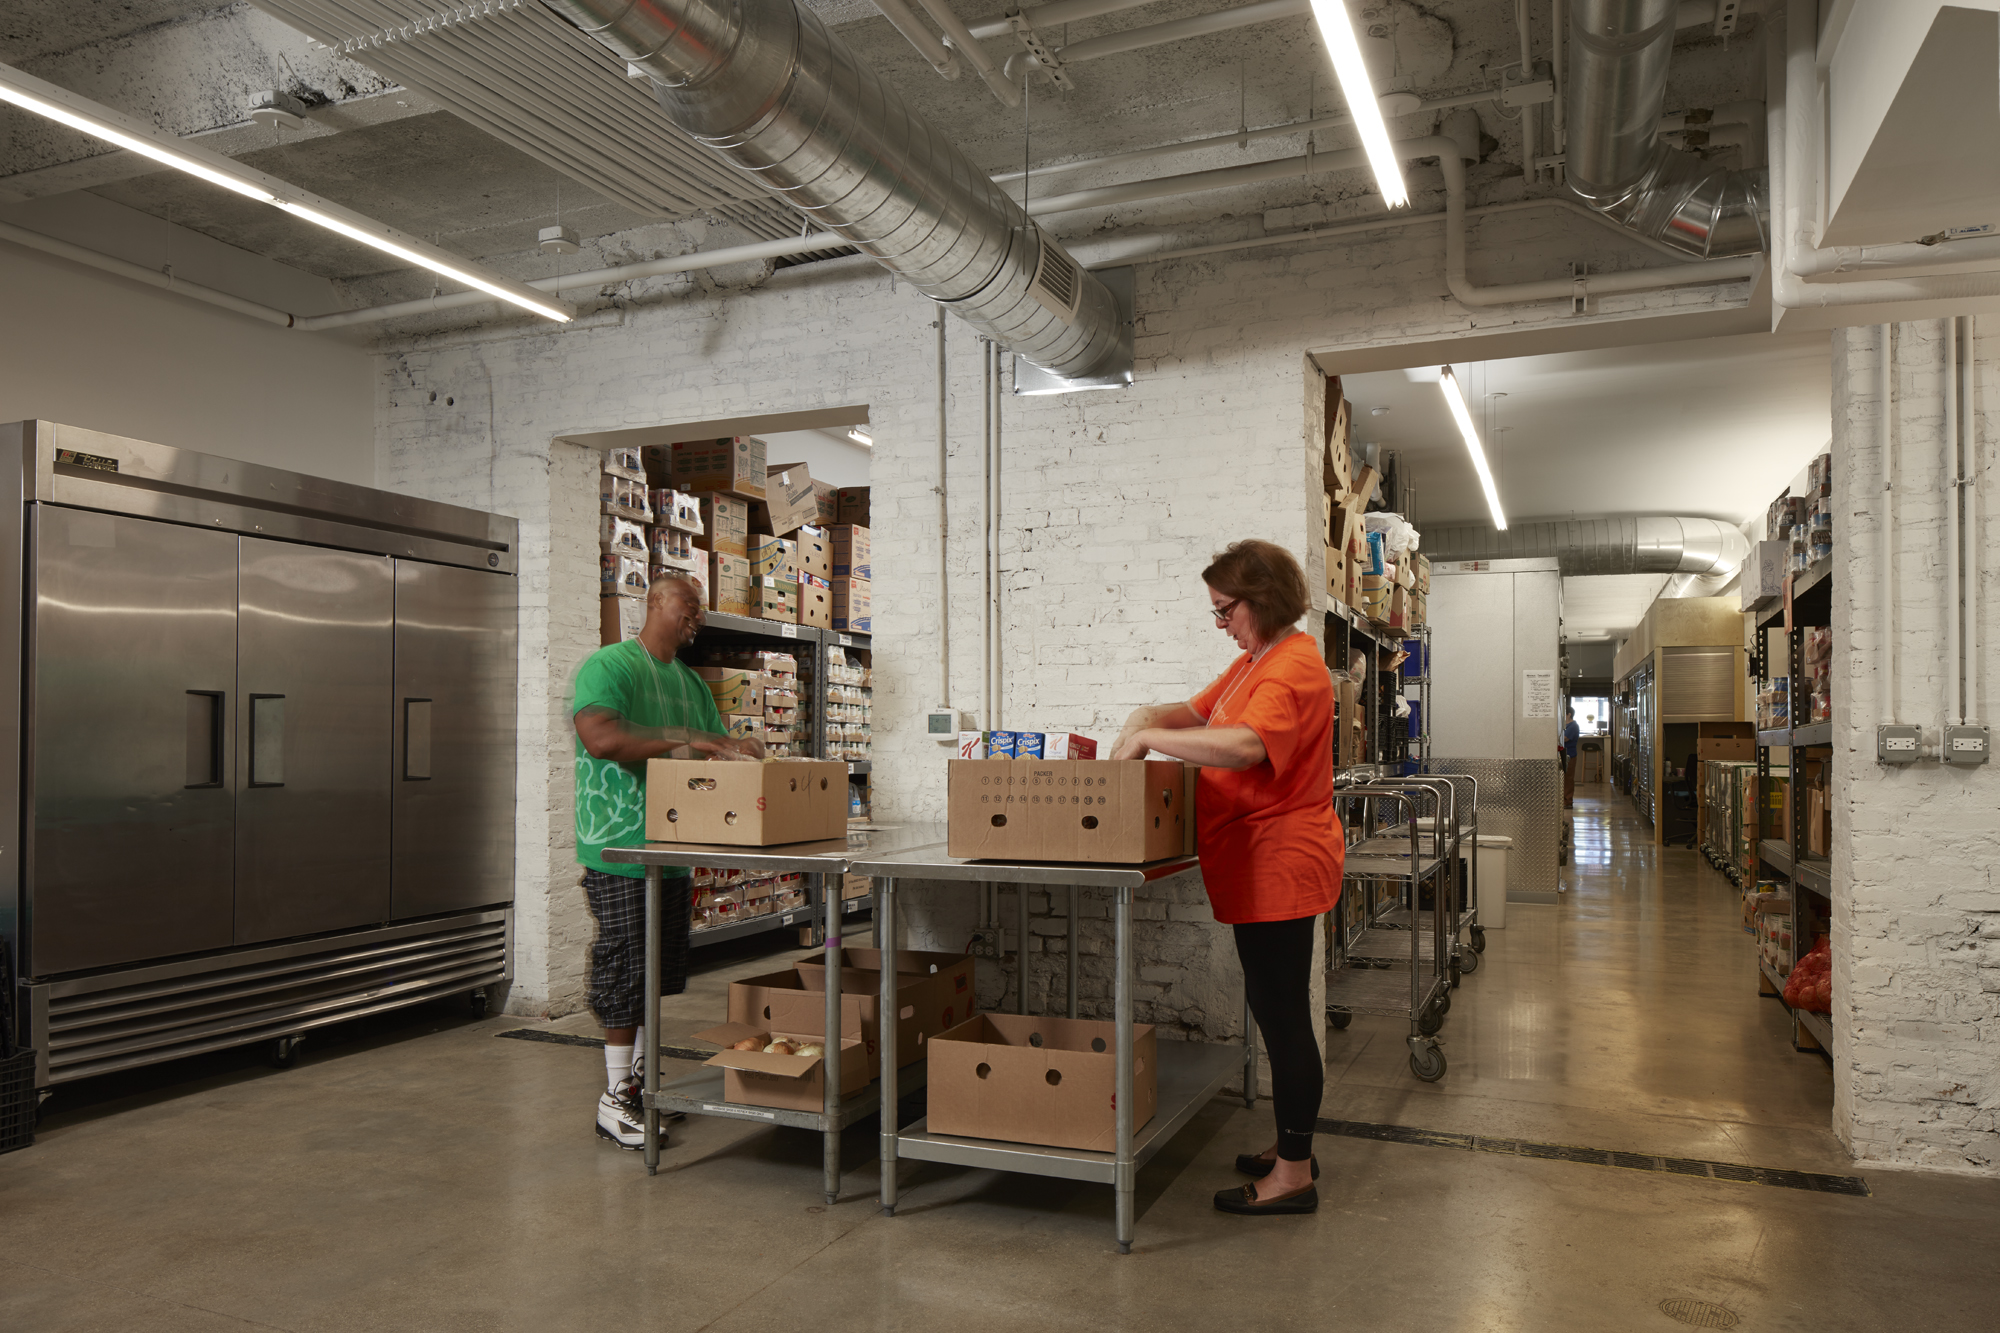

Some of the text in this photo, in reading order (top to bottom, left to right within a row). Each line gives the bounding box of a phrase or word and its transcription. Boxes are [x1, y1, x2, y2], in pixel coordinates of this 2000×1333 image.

[991, 736, 1012, 745] Crispix
[1017, 738, 1040, 747] Crispix
[961, 737, 980, 759] K
[756, 797, 767, 811] S
